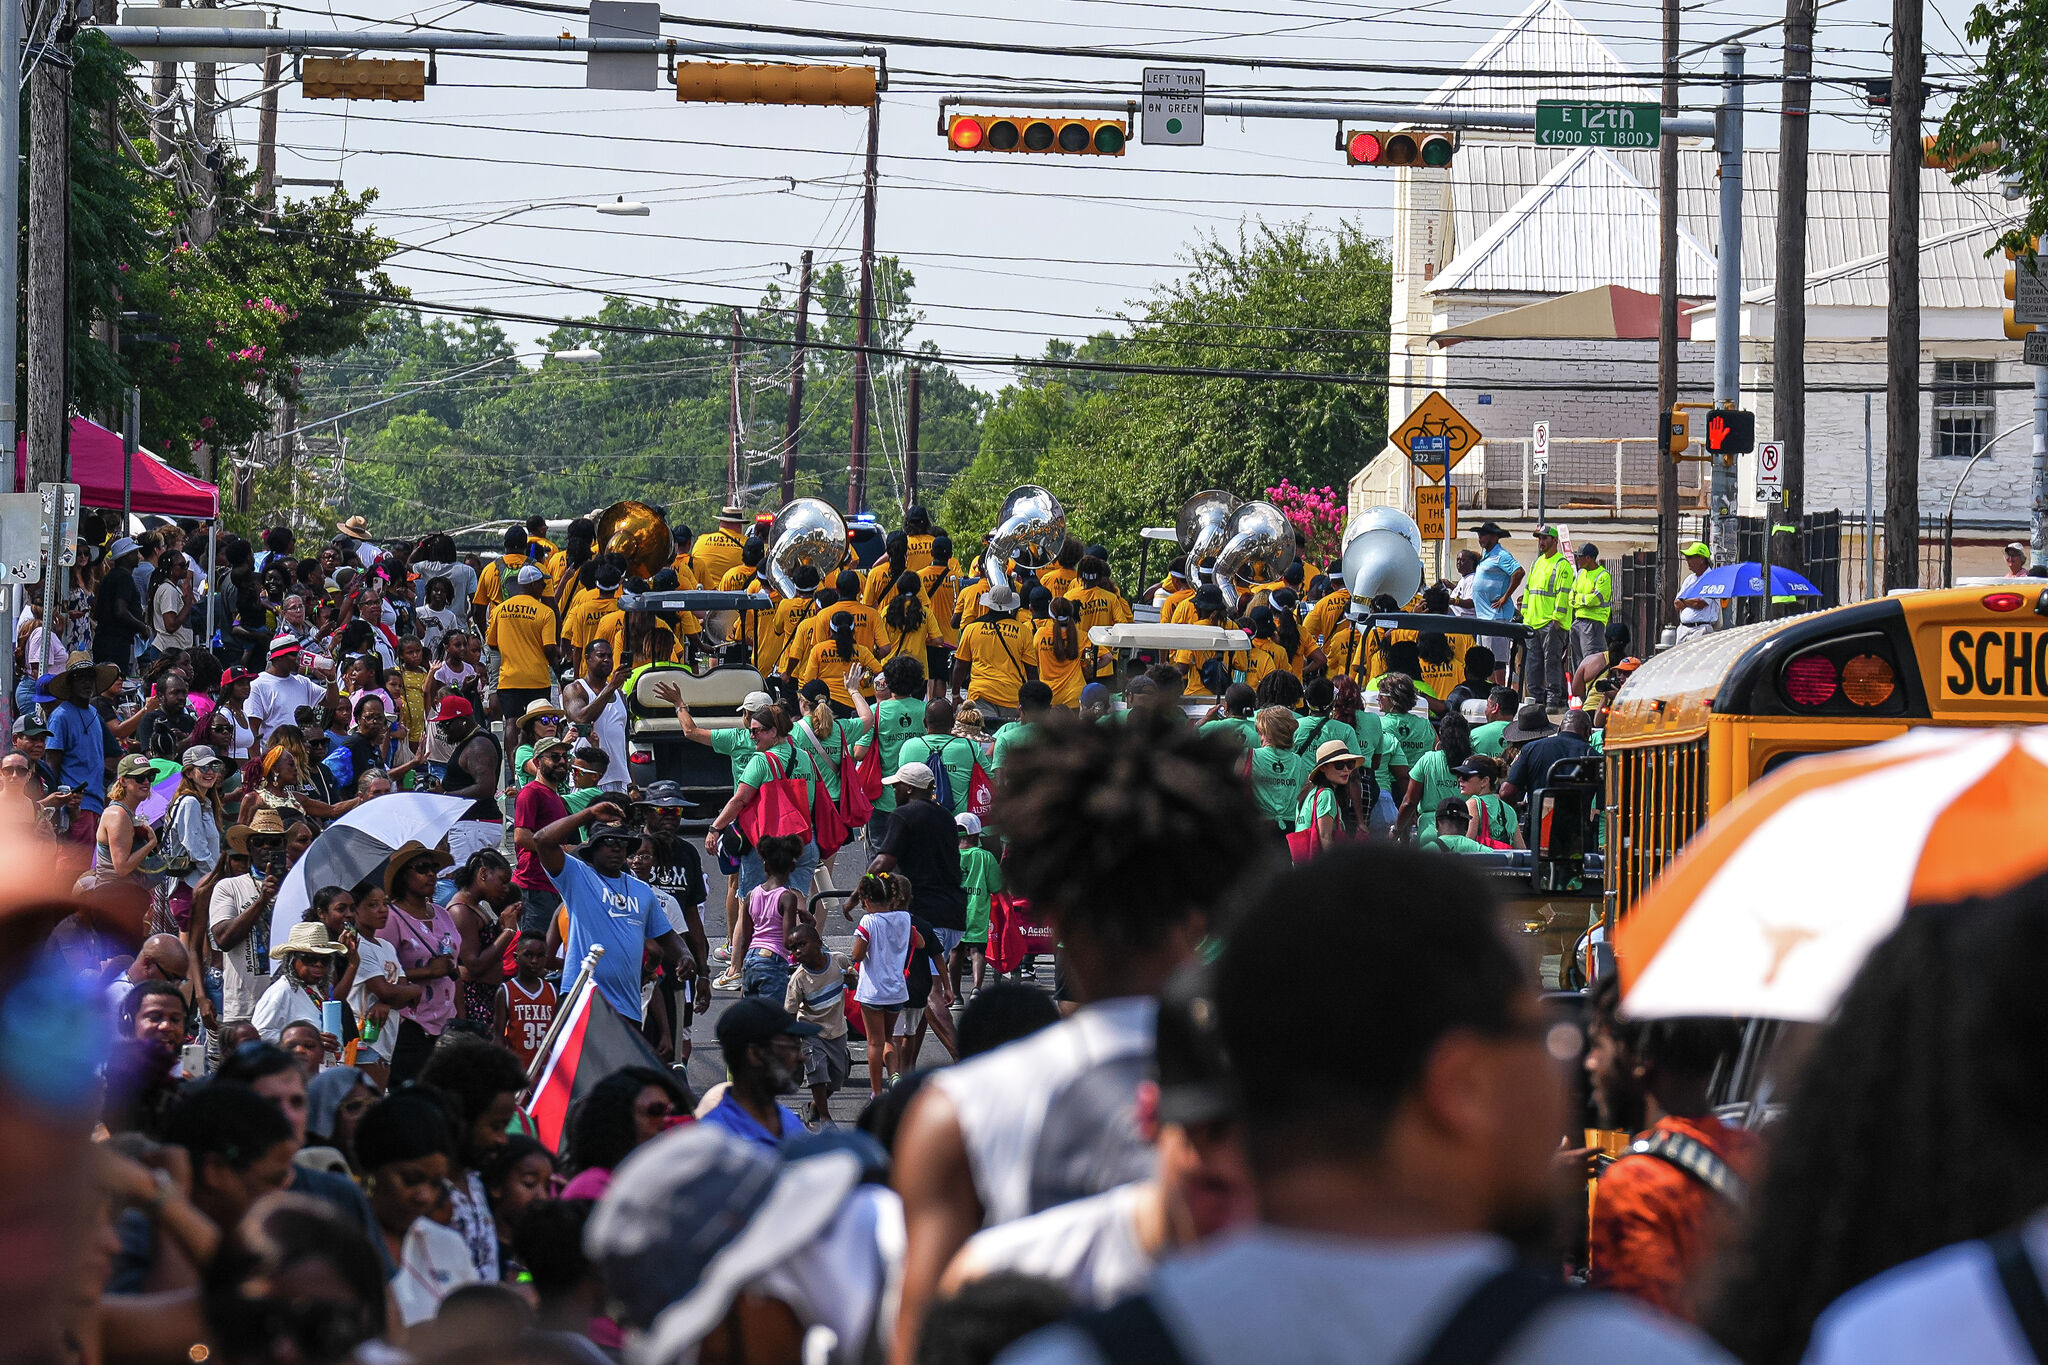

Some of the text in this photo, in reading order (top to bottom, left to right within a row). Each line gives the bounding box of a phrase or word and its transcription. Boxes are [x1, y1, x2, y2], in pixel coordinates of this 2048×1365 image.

[1147, 74, 1201, 85] LEFT TURN
[1158, 88, 1190, 100] YIELD
[1148, 103, 1199, 113] ON GREEN
[1562, 102, 1634, 129] E 12th
[1552, 130, 1643, 145] 1900 ST 1800
[1414, 453, 1429, 462] 322
[1427, 508, 1445, 518] THE
[1424, 524, 1445, 533] ROA
[907, 541, 932, 551] USTI
[501, 604, 538, 616] AUSTIN
[981, 622, 1019, 634] AUSTIN
[1423, 662, 1453, 673] USTIN
[971, 804, 992, 814] AUST
[514, 1004, 552, 1021] TEXAS
[523, 1022, 547, 1050] 35
